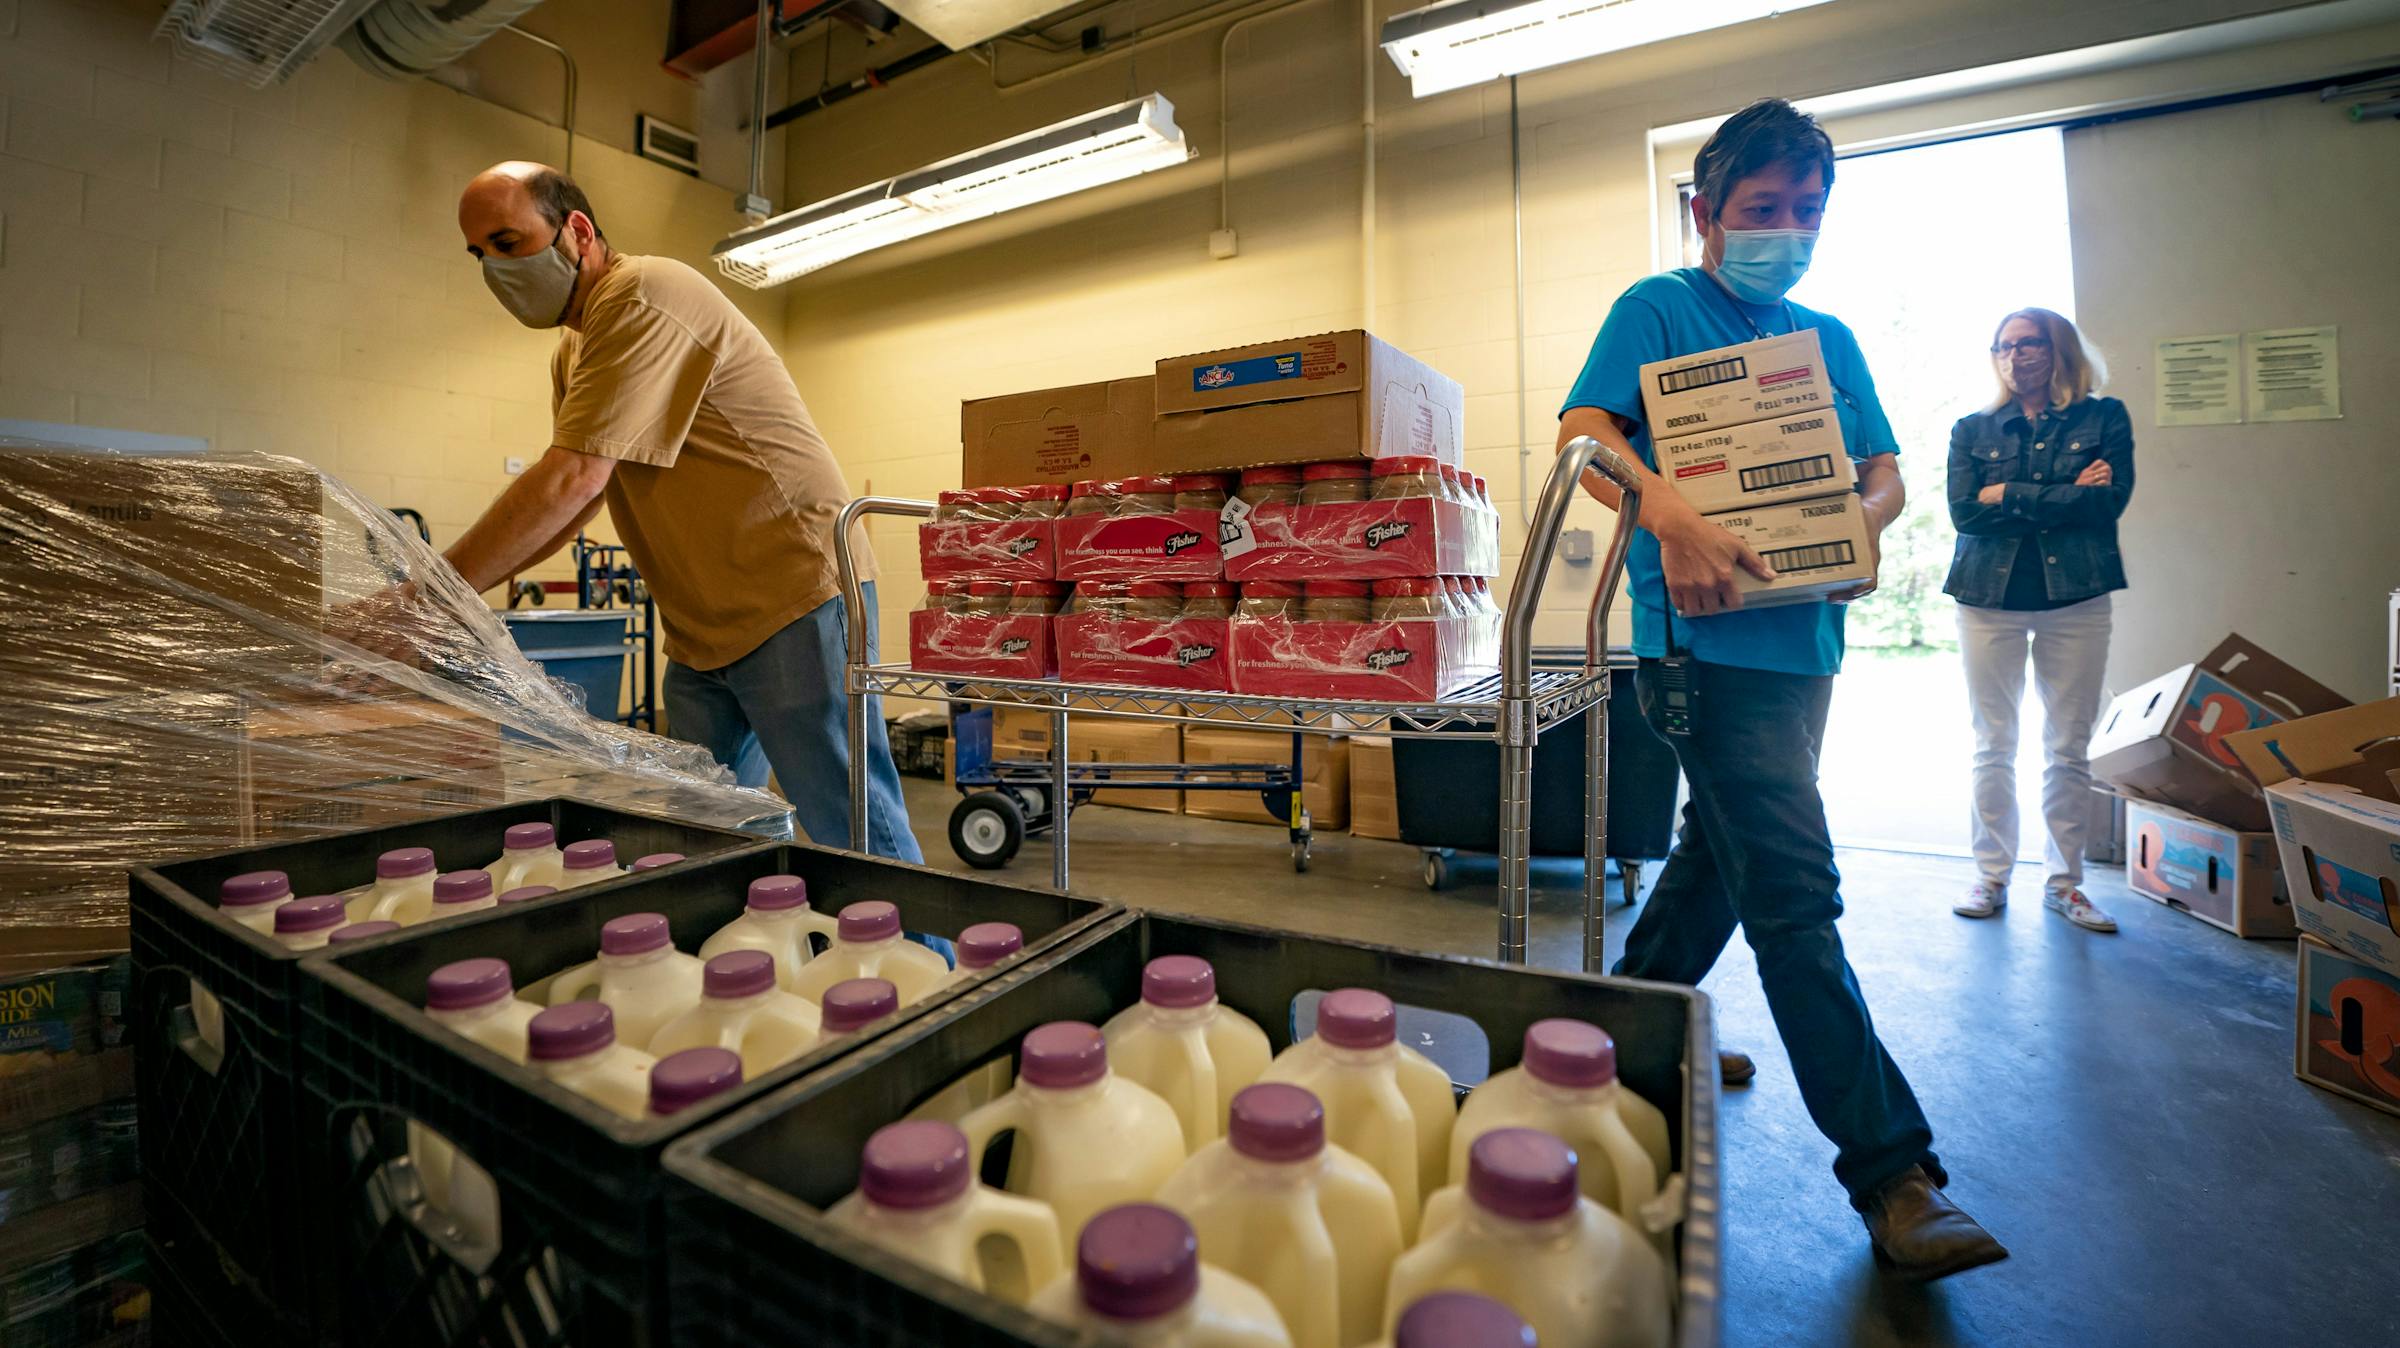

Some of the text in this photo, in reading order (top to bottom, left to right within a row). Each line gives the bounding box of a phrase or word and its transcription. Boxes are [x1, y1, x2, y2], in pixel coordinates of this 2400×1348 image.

[1201, 370, 1233, 384] ANCLA
[1666, 412, 1708, 428] TK00300
[1779, 418, 1824, 435] TK00300
[1670, 445, 1680, 454] 12
[1800, 503, 1846, 519] TK00300
[1255, 540, 1288, 549] eshness
[1368, 521, 1408, 547] Fisher
[1011, 539, 1038, 557] Fisher
[1105, 548, 1118, 556] you
[1118, 547, 1131, 555] can
[1145, 546, 1164, 555] think
[1167, 534, 1199, 555] Fisher
[1003, 639, 1030, 655] Fisher
[1070, 651, 1081, 659] For
[1081, 651, 1113, 660] freshness
[1181, 645, 1213, 665] Fisher
[1237, 659, 1250, 668] For
[1251, 659, 1289, 670] freshness
[1369, 650, 1409, 670] Fisher
